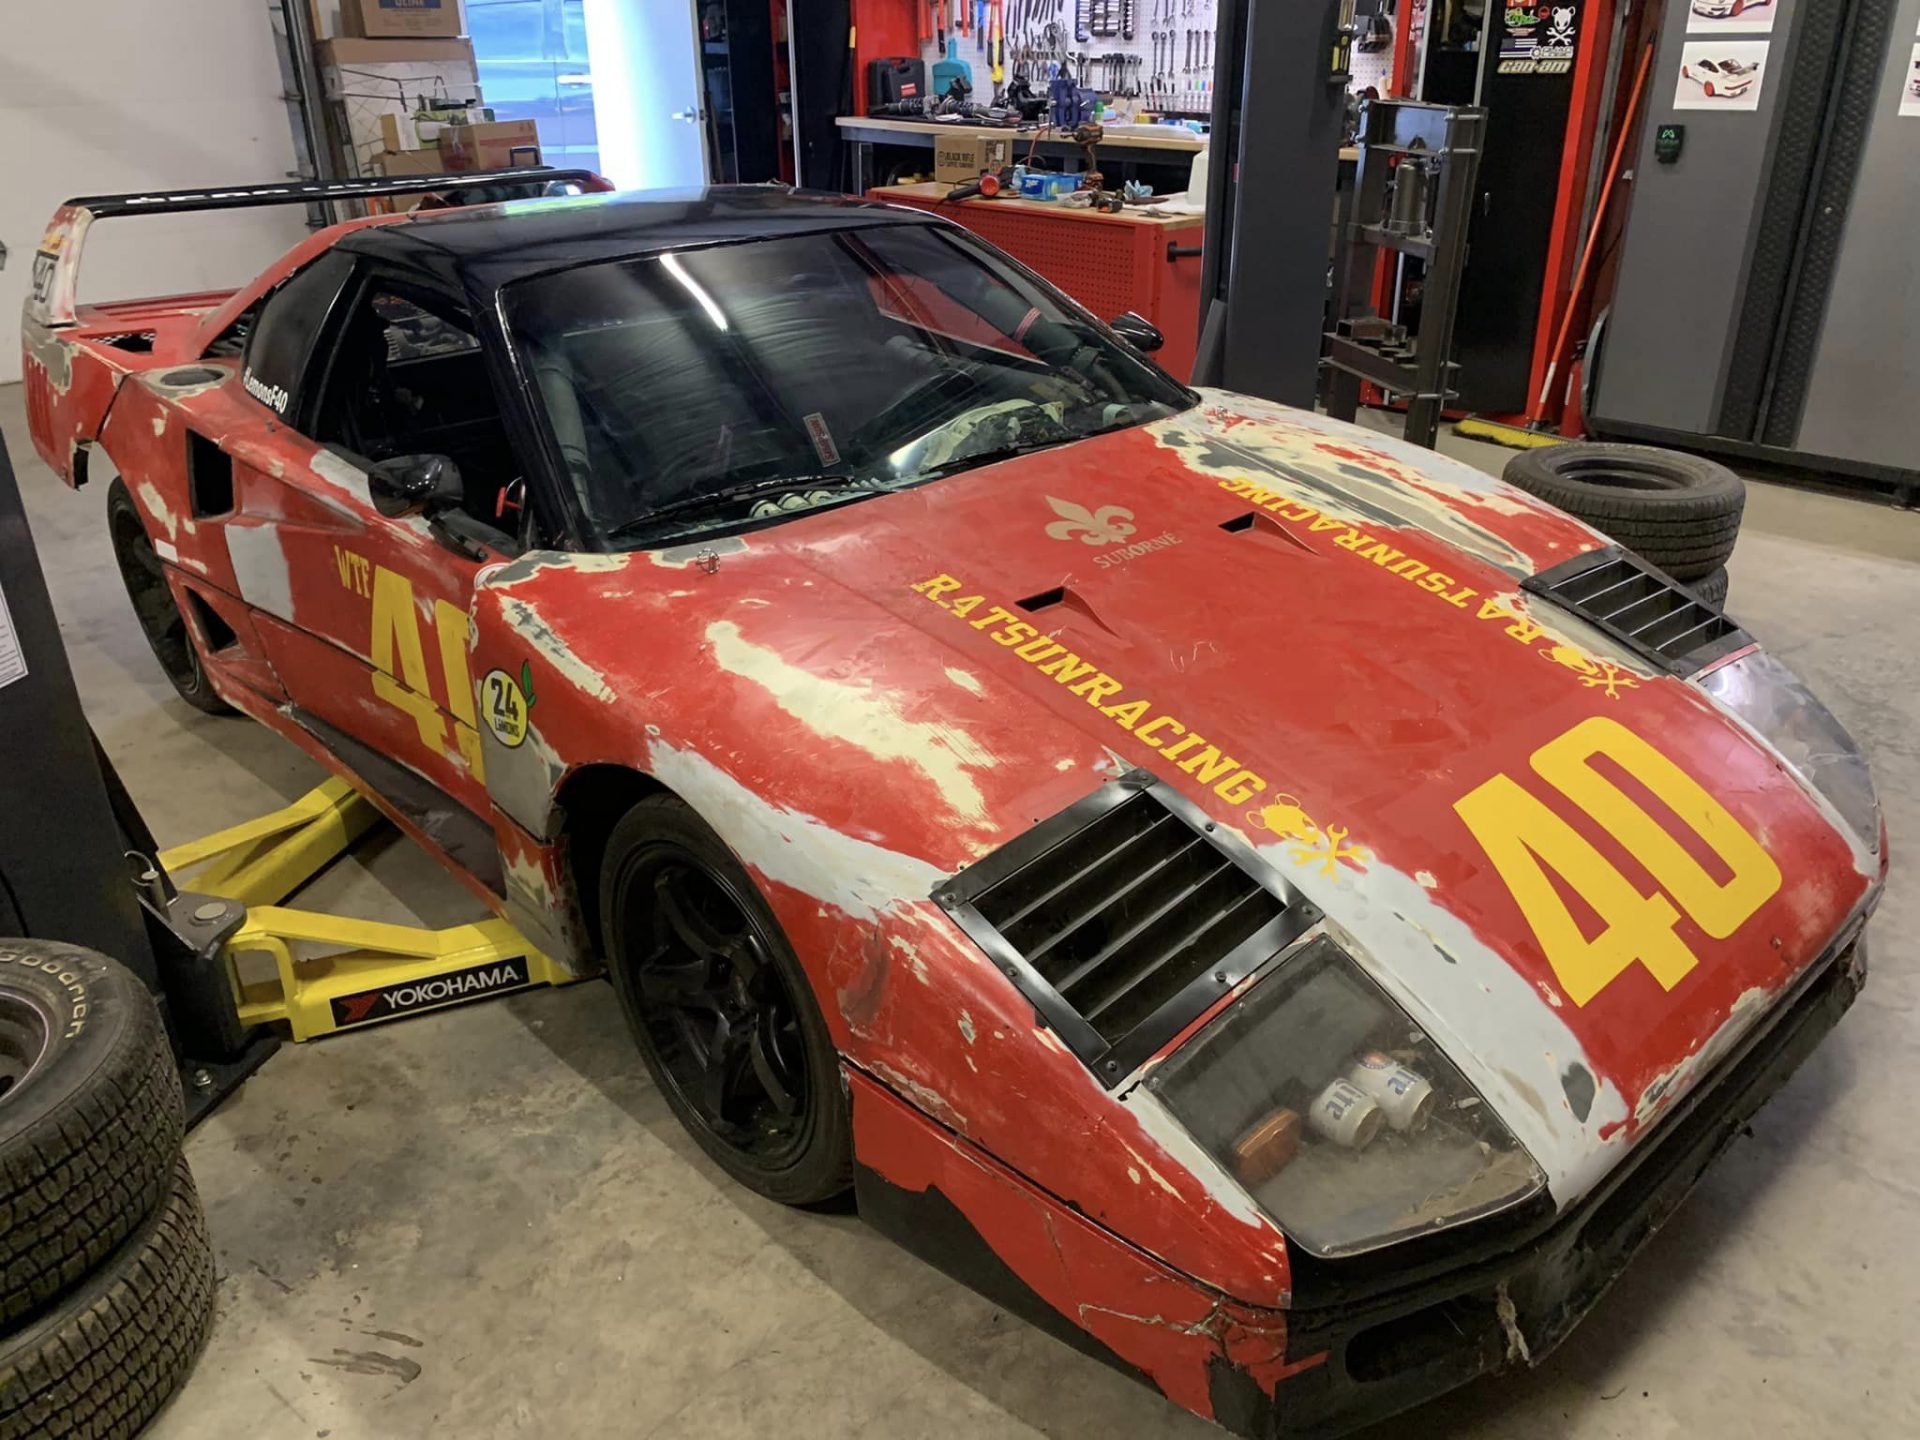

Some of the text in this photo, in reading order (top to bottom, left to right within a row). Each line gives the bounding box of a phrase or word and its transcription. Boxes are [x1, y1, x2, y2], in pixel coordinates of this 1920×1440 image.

[491, 677, 519, 721] 24
[911, 574, 1267, 806] RATSUNRACING
[1452, 716, 1782, 1008] 40
[383, 965, 519, 1008] YOKOHAMA
